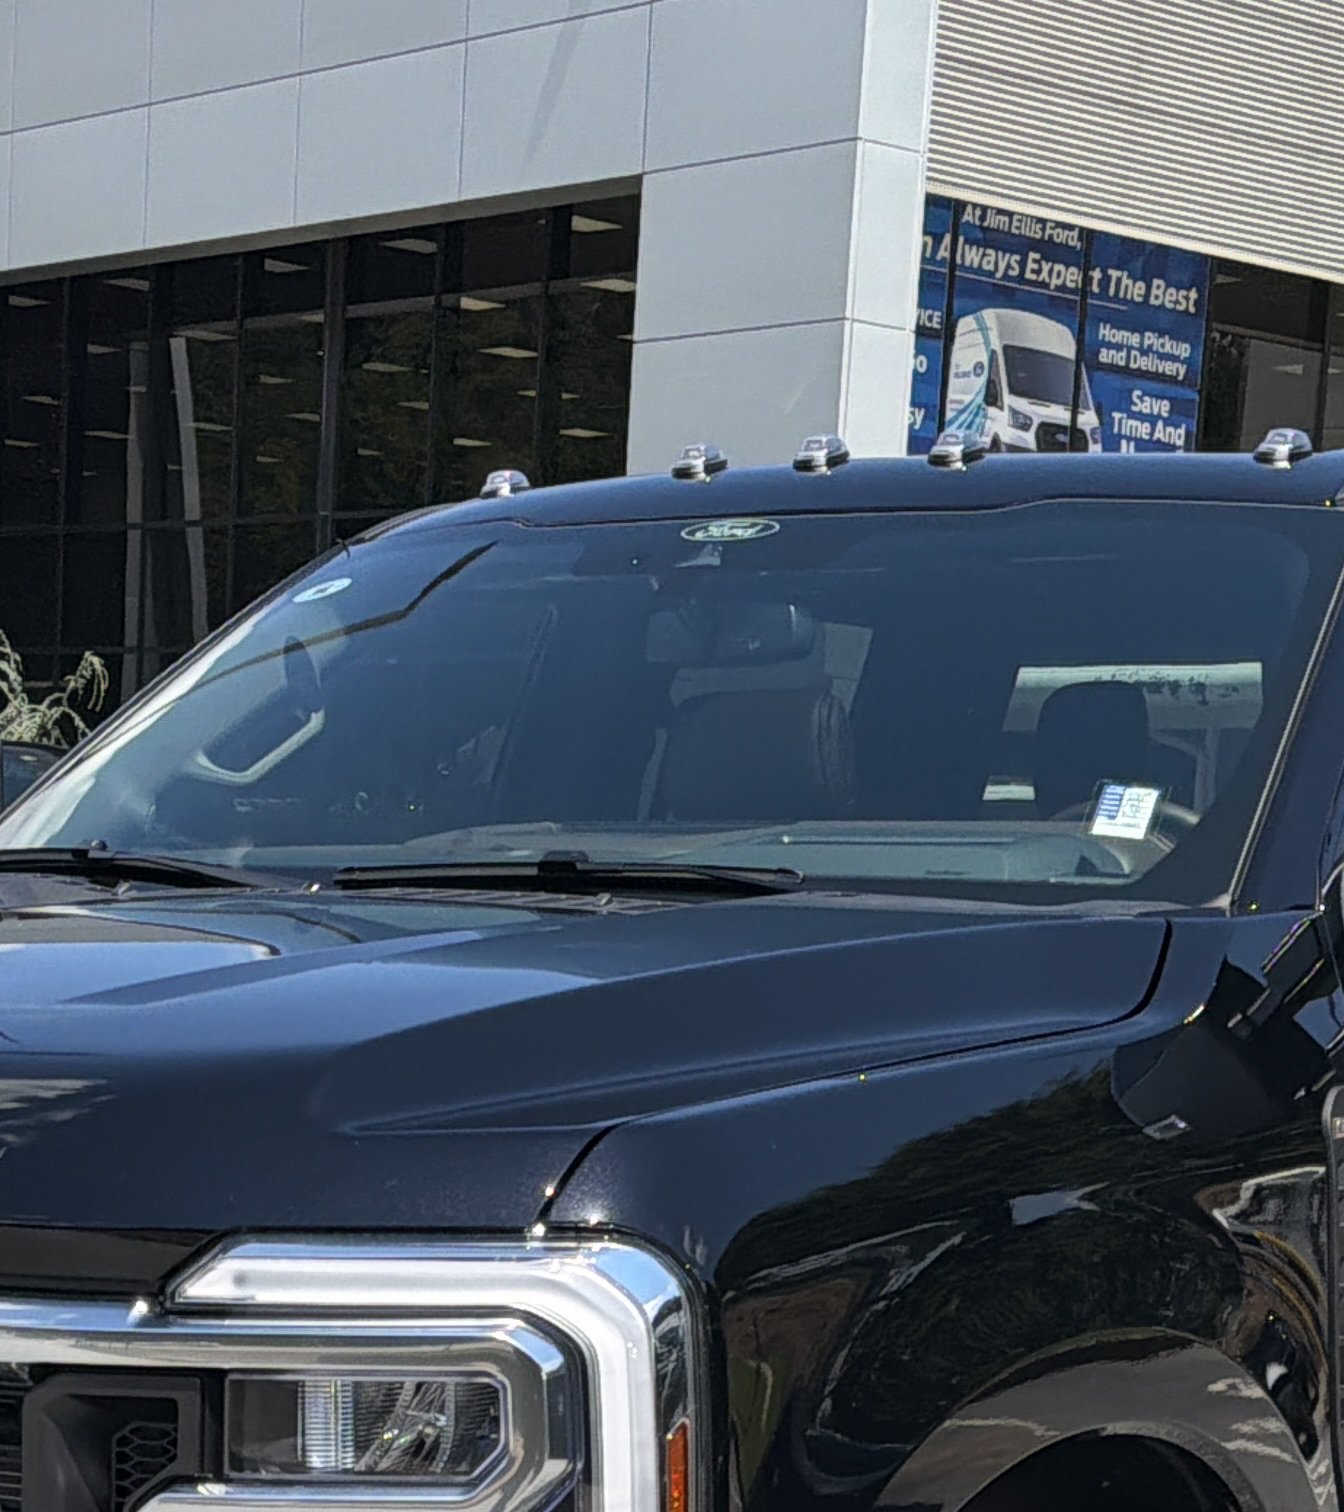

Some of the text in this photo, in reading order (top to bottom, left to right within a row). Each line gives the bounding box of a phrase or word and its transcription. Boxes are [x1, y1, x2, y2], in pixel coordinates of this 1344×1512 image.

[962, 203, 1082, 250] At Jim Ellis Ford,
[937, 232, 1022, 280] Always
[1107, 267, 1146, 302] The
[1149, 278, 1199, 314] Best
[1098, 322, 1192, 360] Home Pickup
[1098, 346, 1188, 381] and Delivery
[1131, 389, 1171, 418] Save
[1112, 411, 1151, 441] Time
[1152, 419, 1186, 447] And
